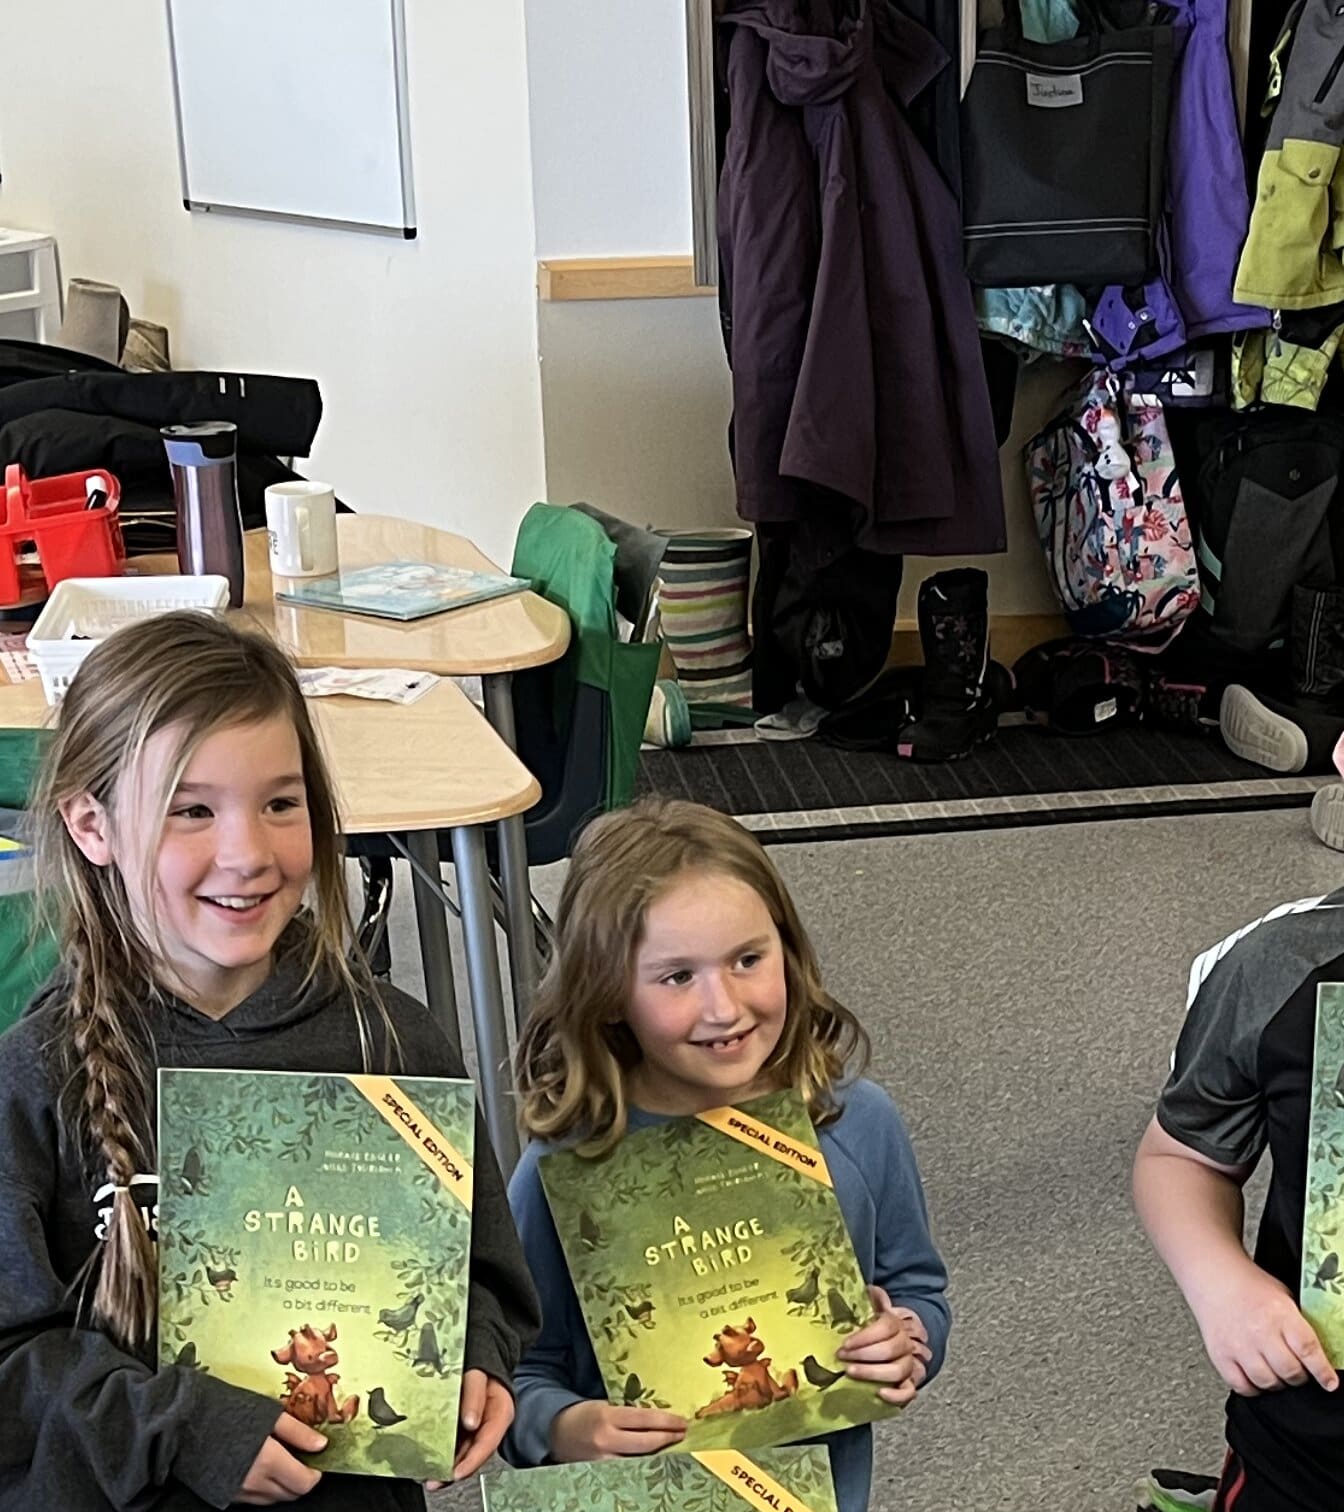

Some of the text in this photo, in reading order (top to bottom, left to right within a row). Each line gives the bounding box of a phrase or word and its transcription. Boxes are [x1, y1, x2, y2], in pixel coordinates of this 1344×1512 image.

[382, 1093, 465, 1183] SPECIAL EDITION
[727, 1116, 818, 1168] SPECIAL EDITION
[284, 1184, 305, 1208] A
[243, 1209, 382, 1238] STRANGE
[672, 1215, 692, 1236] A
[643, 1216, 765, 1266] STRANGE
[285, 1279, 321, 1293] good
[323, 1280, 338, 1291] to
[339, 1280, 356, 1293] be
[696, 1284, 727, 1304] good
[729, 1282, 743, 1293] to
[743, 1278, 760, 1289] be
[282, 1299, 372, 1315] a bit different
[699, 1291, 779, 1319] a bit different
[731, 1465, 781, 1512] SPECIAL
